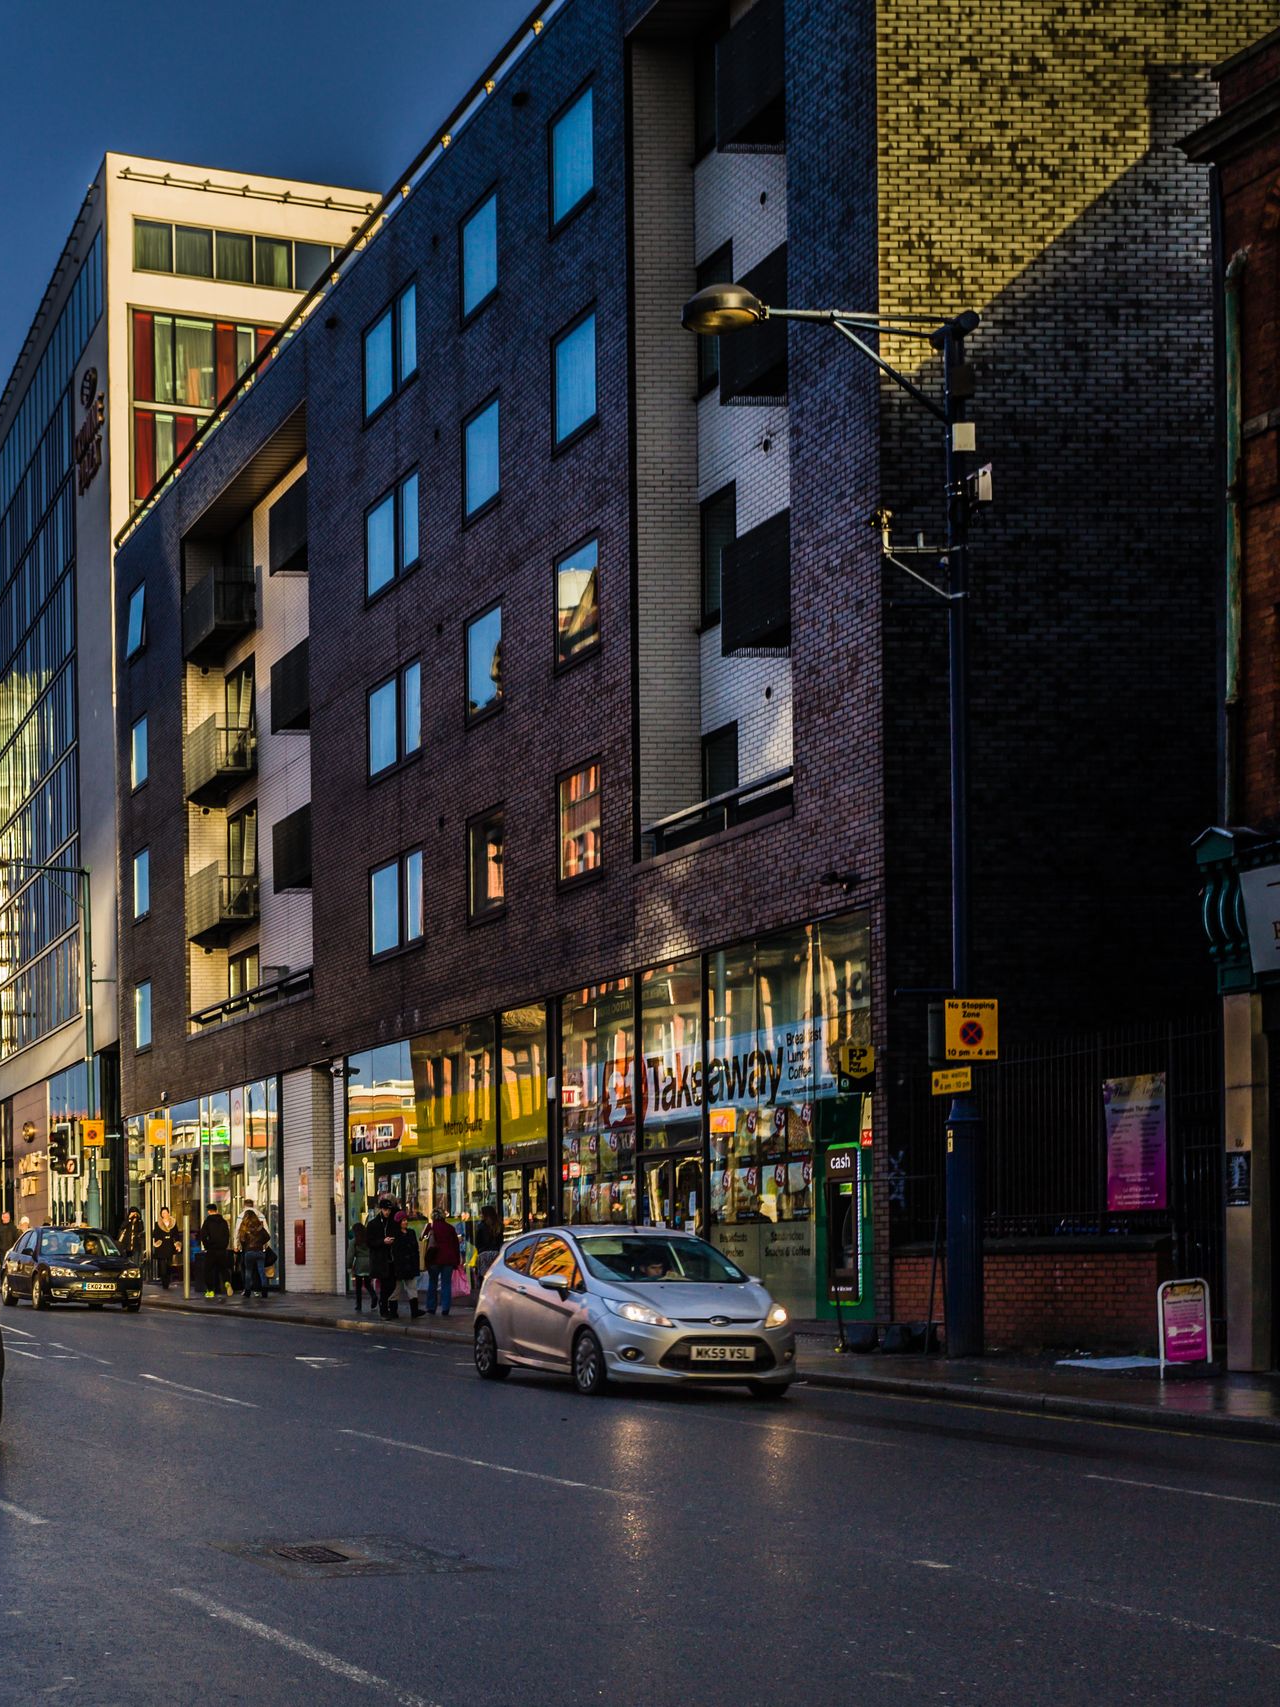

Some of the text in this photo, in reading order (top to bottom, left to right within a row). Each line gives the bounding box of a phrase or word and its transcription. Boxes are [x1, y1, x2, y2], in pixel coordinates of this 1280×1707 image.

[961, 1001, 995, 1010] Stopping
[786, 1027, 822, 1046] Breaast
[947, 1048, 957, 1056] 10
[959, 1049, 970, 1057] pm
[647, 1047, 784, 1112] Takeaway
[788, 1064, 812, 1080] Coffee
[443, 1121, 464, 1137] Metro
[830, 1154, 851, 1169] cash
[695, 1348, 750, 1359] MK59 VSL
